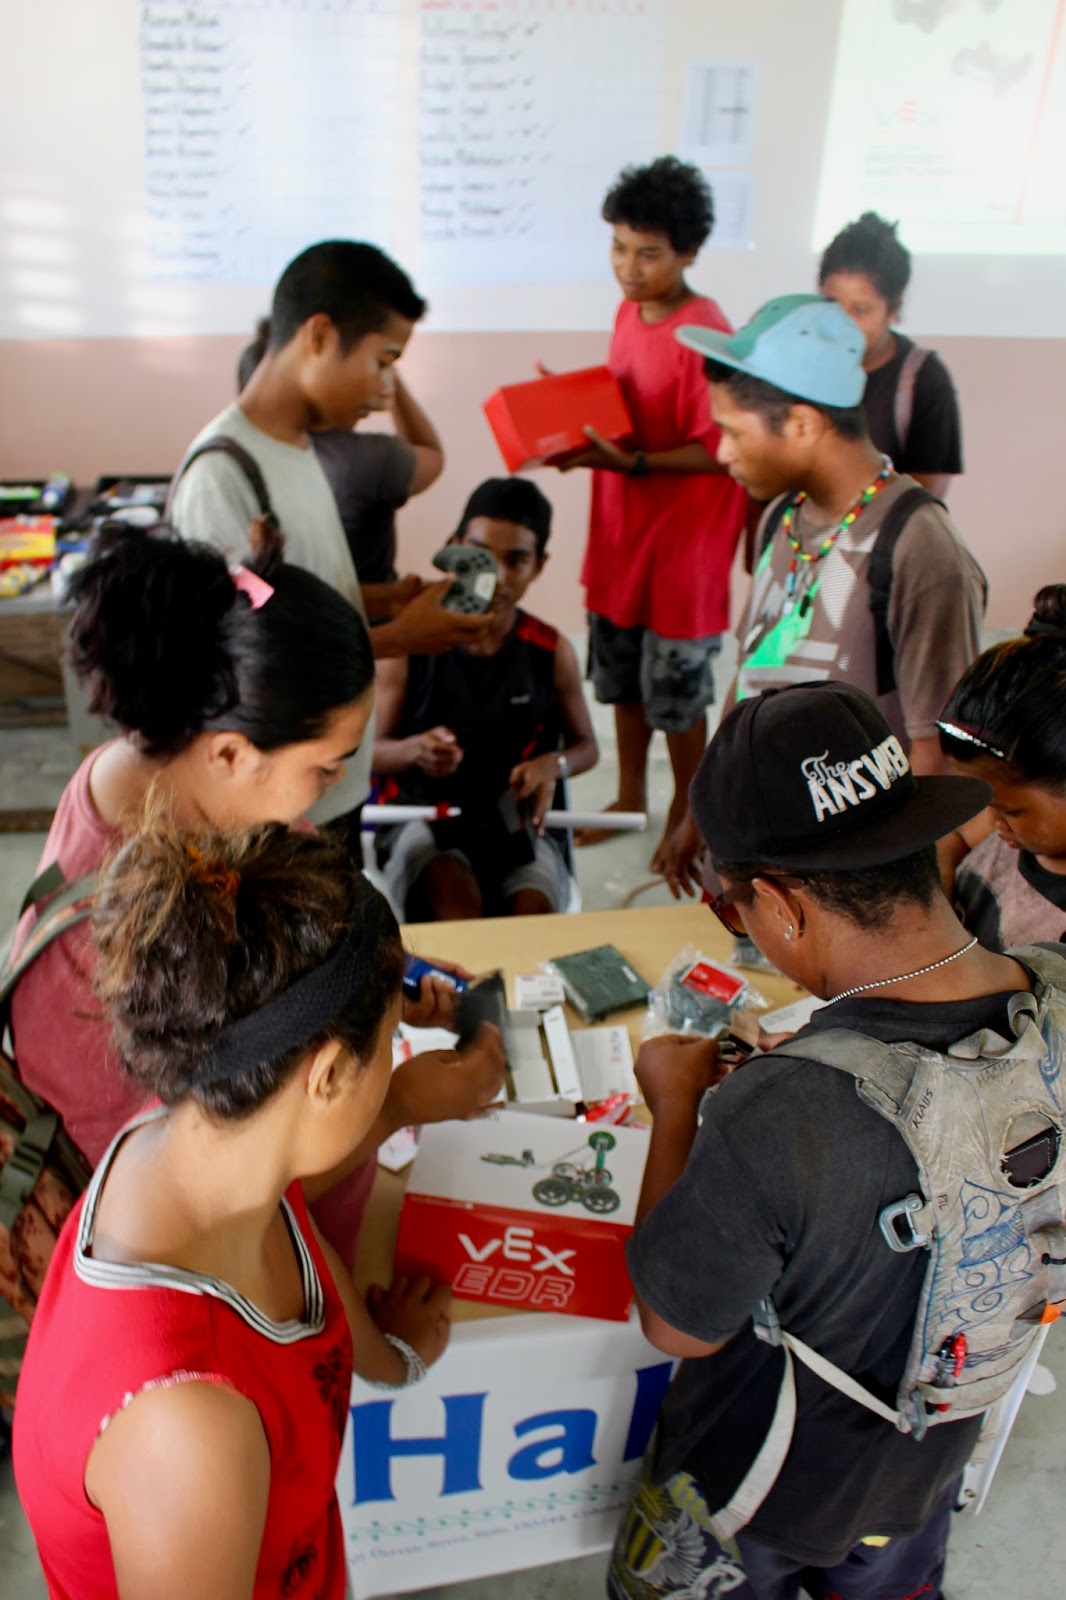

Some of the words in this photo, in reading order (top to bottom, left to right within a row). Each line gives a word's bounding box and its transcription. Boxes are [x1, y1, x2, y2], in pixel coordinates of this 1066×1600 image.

[801, 750, 850, 786] The
[911, 1087, 934, 1129] KLAUS
[457, 1226, 577, 1277] VEX
[451, 1263, 576, 1308] EDR
